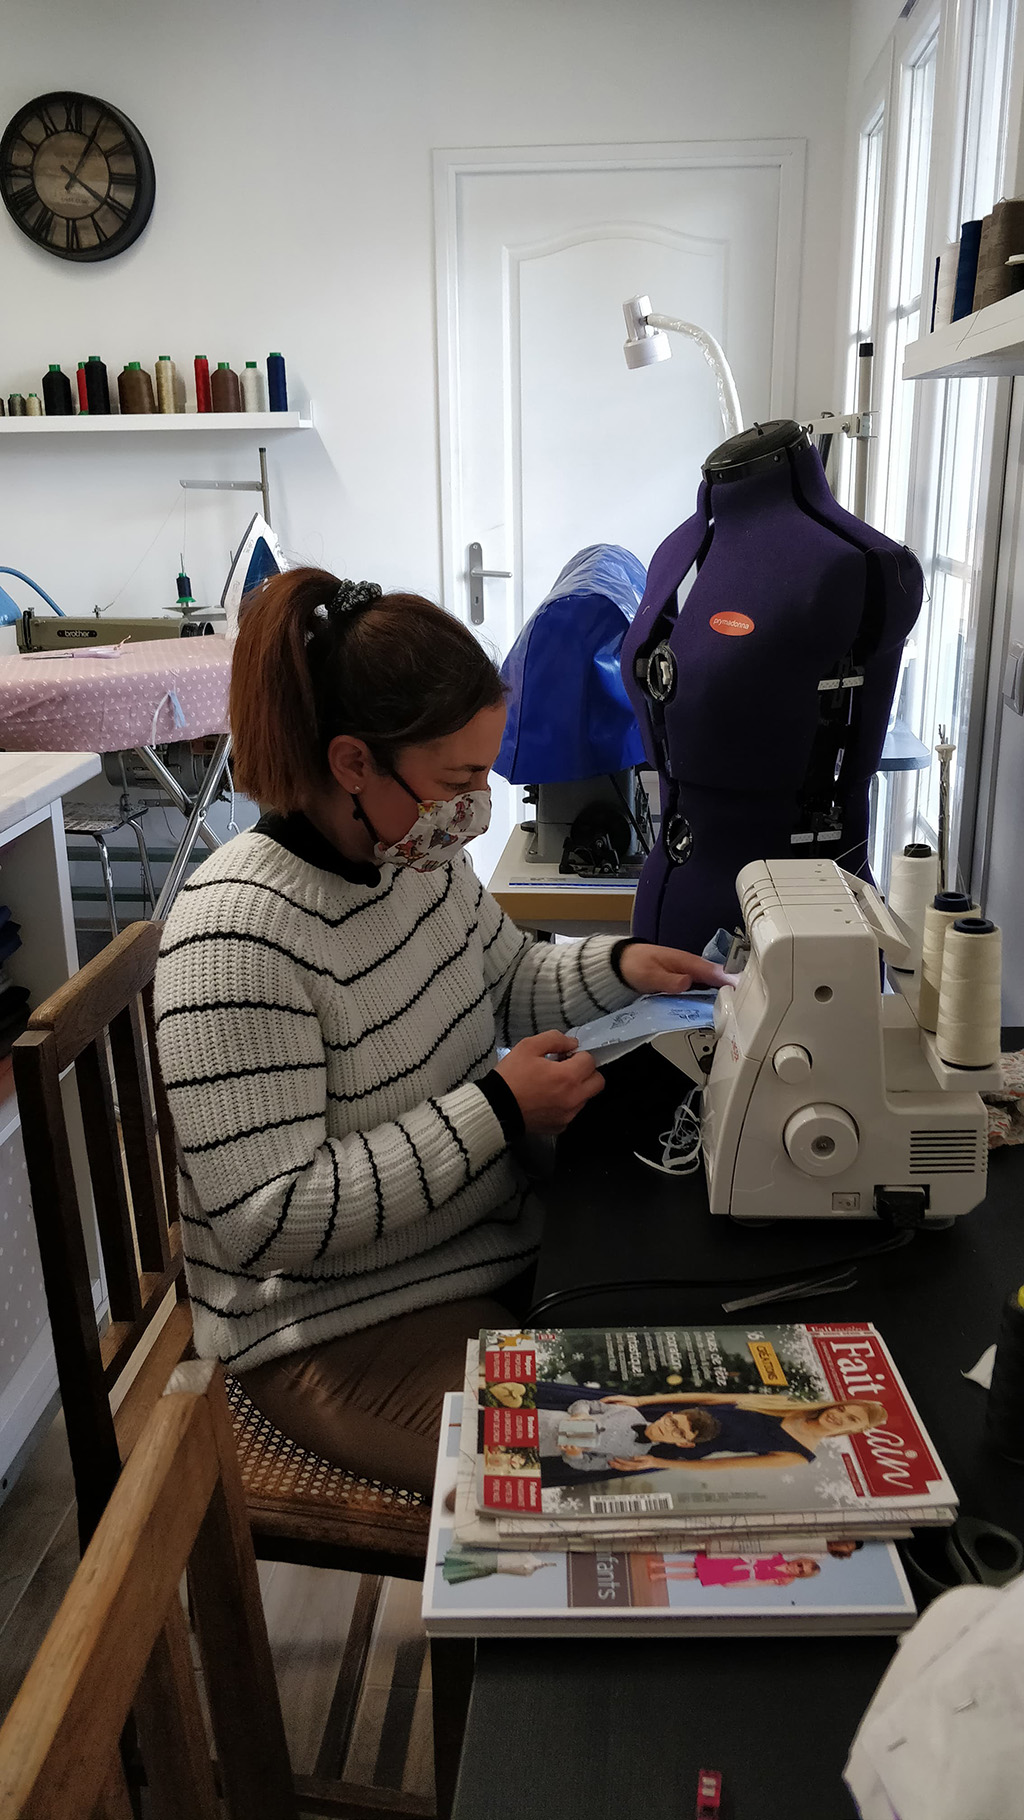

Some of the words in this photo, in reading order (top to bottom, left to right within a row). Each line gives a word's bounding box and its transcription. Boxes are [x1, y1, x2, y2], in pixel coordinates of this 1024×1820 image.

[713, 618, 750, 630] prymadonna
[64, 629, 91, 638] brother
[710, 1353, 723, 1365] de
[713, 1366, 728, 1386] fête
[830, 1340, 885, 1396] Fait
[863, 1423, 918, 1489] ain
[527, 1416, 535, 1439] Broderie
